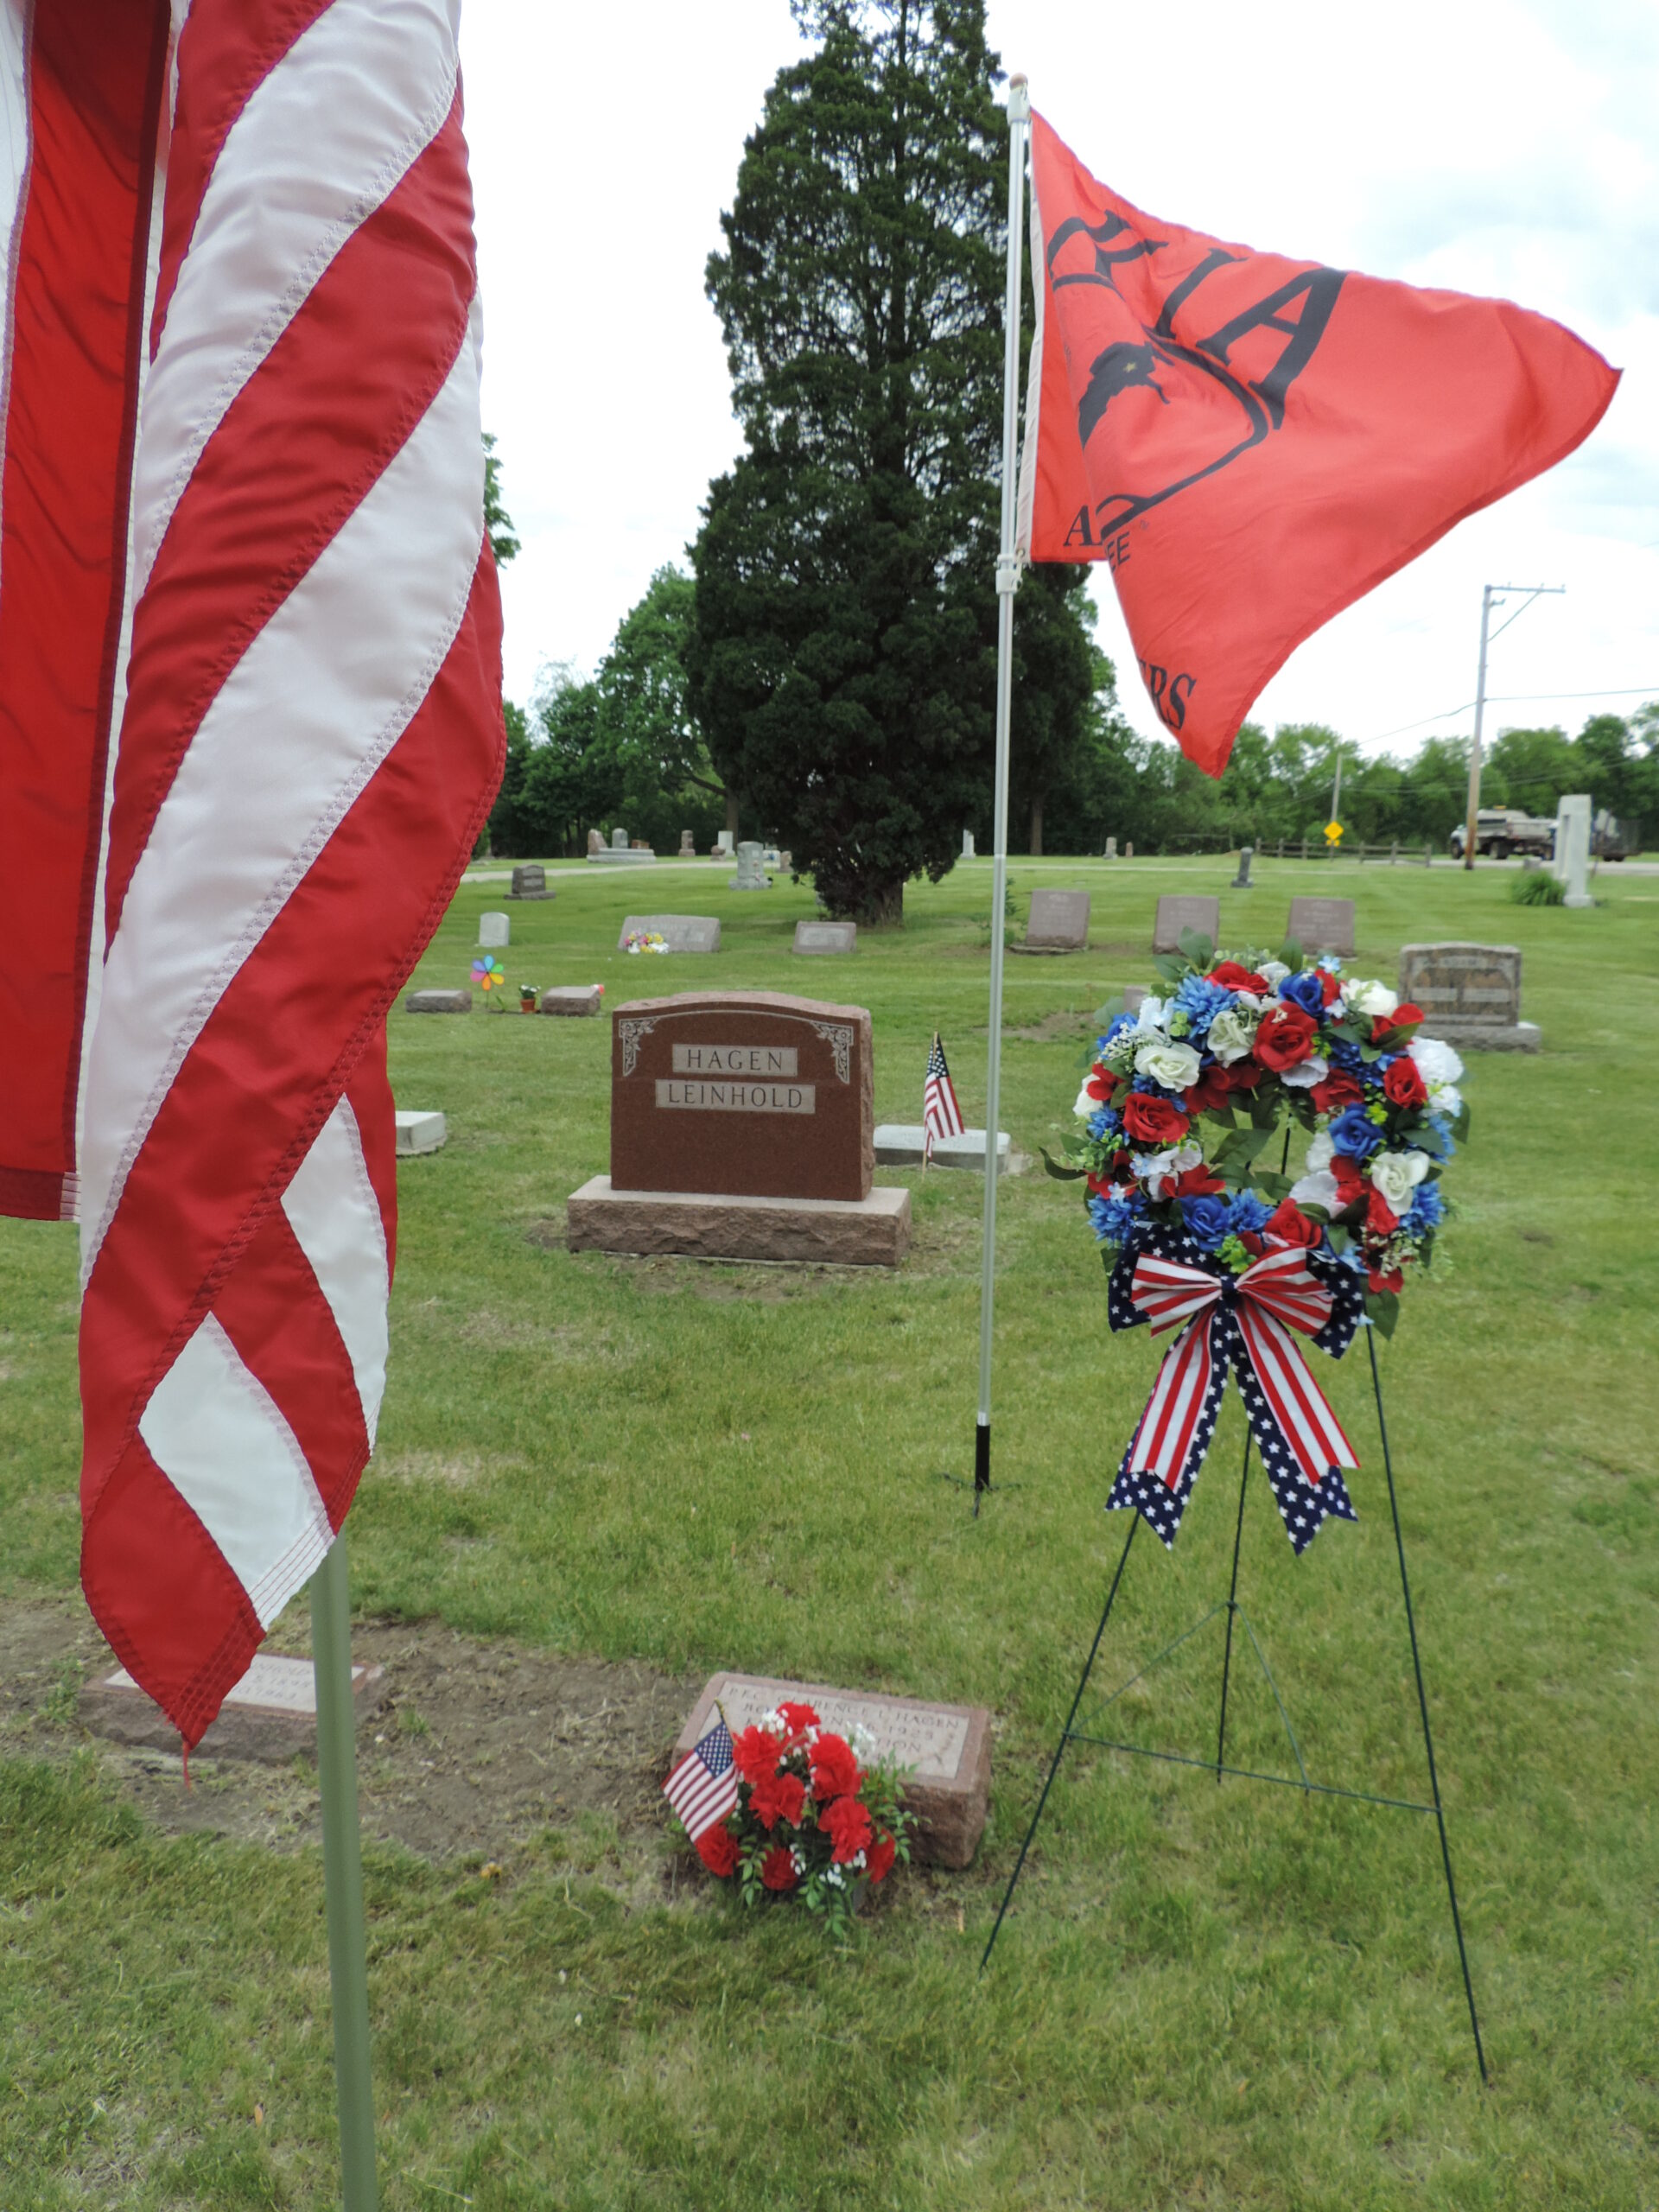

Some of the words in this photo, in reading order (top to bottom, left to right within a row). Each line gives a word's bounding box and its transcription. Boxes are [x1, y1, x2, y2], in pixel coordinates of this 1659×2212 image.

[687, 1049, 783, 1071] HAGEN
[668, 1084, 803, 1109] LEINHOLD
[895, 1713, 959, 1729] HAGEN
